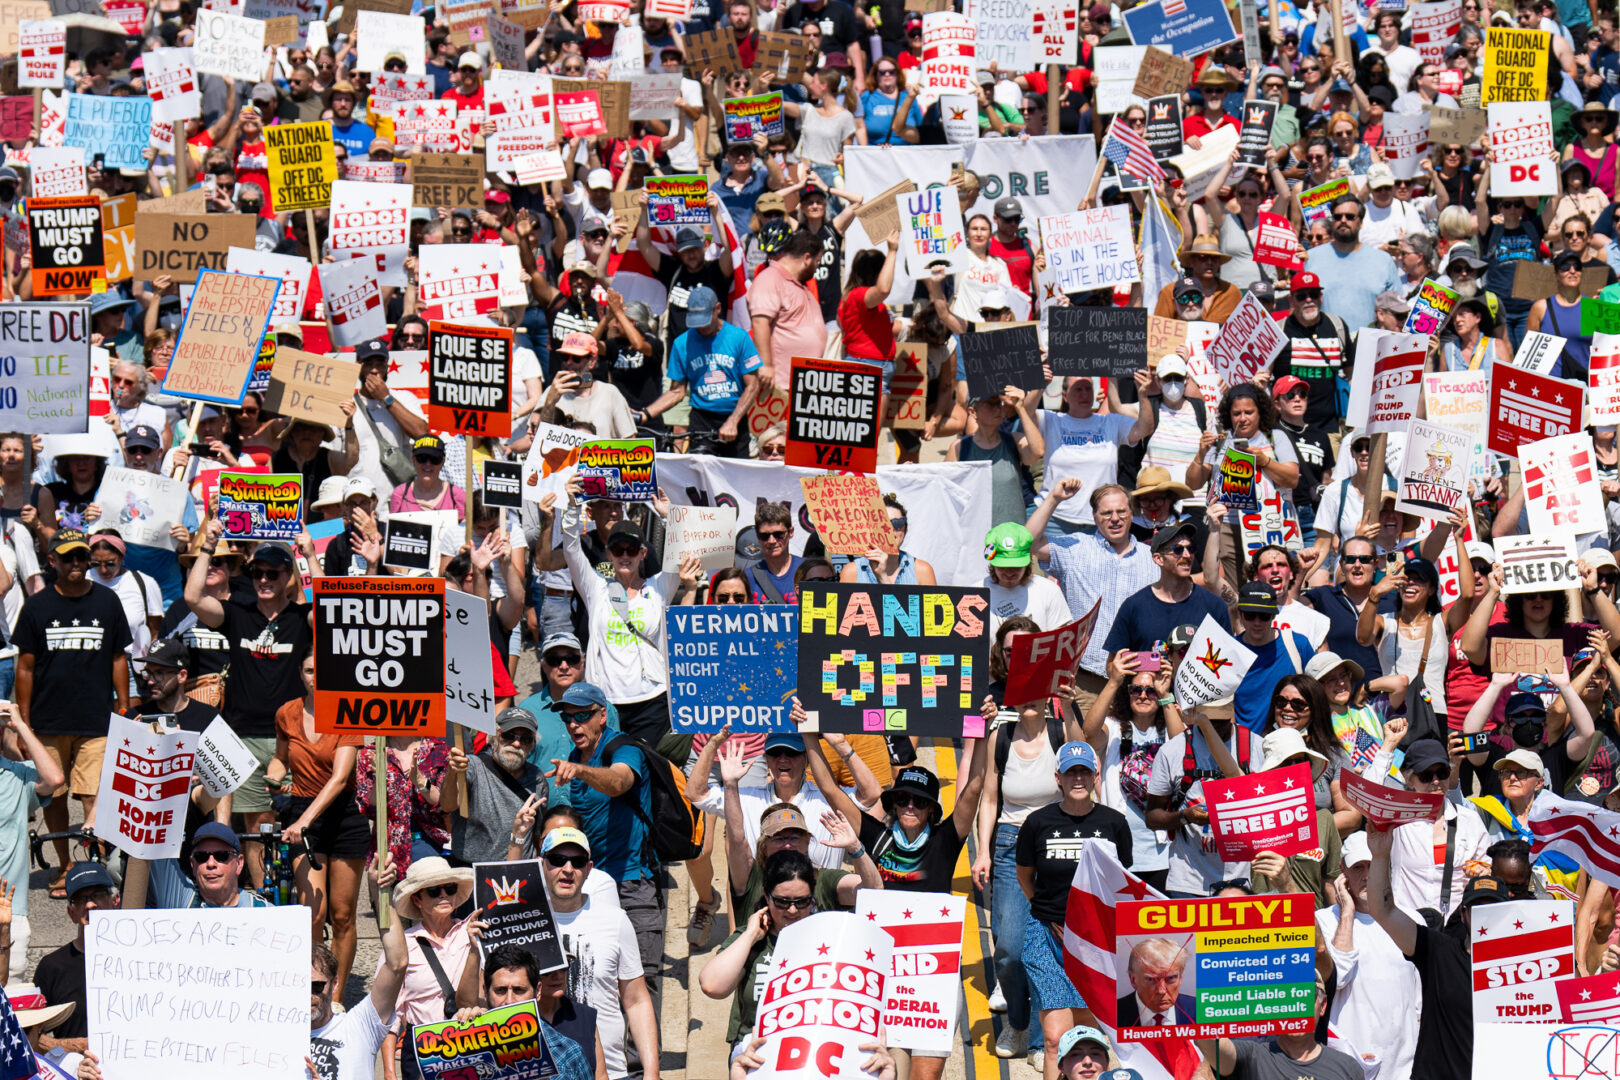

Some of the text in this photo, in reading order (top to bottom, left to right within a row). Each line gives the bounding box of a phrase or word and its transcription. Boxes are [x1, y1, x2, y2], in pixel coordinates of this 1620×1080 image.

[1413, 7, 1460, 29] PROTECT
[923, 27, 975, 44] PROTECT
[1043, 36, 1065, 44] ALL
[1151, 16, 1215, 44] the Occupation
[1489, 31, 1545, 50] NATIONAL
[1046, 47, 1062, 56] DC
[1496, 50, 1536, 68] GUARD
[25, 61, 57, 69] HOME
[28, 70, 55, 78] RULE
[927, 64, 969, 77] HOME
[930, 77, 967, 88] RULE
[1496, 72, 1533, 87] OFF DC
[68, 98, 150, 123] EL PUEBLO
[267, 126, 330, 147] NATIONAL
[1494, 122, 1550, 143] TODOS
[280, 145, 322, 166] GUARD
[283, 167, 323, 186] OFF DC
[1510, 164, 1539, 182] DC
[414, 185, 478, 206] FREE DC
[30, 208, 100, 228] TRUMP
[334, 208, 406, 228] TODOS
[1045, 207, 1120, 230] THE REAL
[39, 227, 94, 247] MUST
[173, 222, 208, 242] NO
[334, 229, 406, 249] SOMOS
[912, 226, 943, 242] THIS
[1044, 230, 1113, 250] CRIMINAL
[914, 231, 963, 255] TOGETHER
[53, 247, 82, 265] GO
[1051, 243, 1119, 266] IS IN THE
[45, 270, 98, 289] NOW!
[1096, 260, 1138, 284] HOUSE
[199, 272, 270, 299] RELEASE
[329, 278, 378, 312] FUERA
[421, 273, 499, 300] FUERA
[199, 297, 269, 317] the EPSTEIN
[441, 299, 477, 316] ICE
[1053, 308, 1146, 331] STOP KIDNAPPING
[434, 337, 505, 360] ¡QUE SE
[292, 360, 331, 387] FREE
[434, 358, 505, 383] LARGUE
[697, 382, 738, 399] AMERICA
[796, 369, 875, 396] ¡QUE SE
[290, 390, 313, 413] DC
[435, 381, 503, 408] TRUMP
[27, 403, 73, 420] Guard
[795, 392, 873, 425] LARGUE
[1374, 402, 1404, 411] TRUMP
[452, 410, 487, 432] YA!
[796, 416, 870, 443] TRUMP
[1499, 407, 1541, 433] FREE
[414, 435, 438, 448] SPIRIT
[814, 444, 853, 467] YA!
[621, 466, 652, 485] NOW
[1410, 470, 1456, 488] PREVENT
[486, 484, 519, 495] FREE DC
[1404, 483, 1462, 508] TYRANNY
[267, 503, 297, 526] NOW
[813, 508, 887, 523] TAKEOVER
[390, 543, 427, 555] FREE DC
[828, 529, 891, 548] CONTROL
[1503, 560, 1578, 585] FREE DC
[321, 581, 435, 592] RefuseFascism.org
[319, 598, 440, 626] TRUMP
[801, 590, 988, 638] HANDS
[675, 612, 794, 634] VERMONT
[332, 628, 428, 657] MUST
[674, 641, 759, 657] RODE ALL
[1495, 641, 1560, 667] FREE DC
[355, 659, 405, 687] GO
[675, 663, 720, 676] NIGHT
[822, 649, 973, 709] OFF!
[1185, 660, 1224, 697] NO KINGS.
[677, 682, 697, 696] TO
[335, 698, 431, 726] NOW!
[678, 705, 785, 726] SUPPORT
[119, 754, 192, 776] PROTECT
[204, 736, 241, 783] TAKEOVER.
[135, 781, 162, 800] DC
[118, 798, 174, 827] HOME
[1219, 806, 1309, 835] FREE DC
[119, 818, 167, 844] RULE
[482, 910, 544, 925] NO KINGS.
[1138, 899, 1292, 929] GUILTY!
[95, 917, 302, 955] ROSES ARE RED
[484, 919, 549, 938] NO TRUMP
[1203, 932, 1309, 948] Impeached Twice
[1201, 953, 1310, 969] Convicted of 34
[92, 953, 307, 993] FRASIER'S BROTHER IS NILES
[771, 963, 880, 1001] TODOS
[1228, 970, 1283, 982] Felonies
[1486, 957, 1560, 988] STOP
[896, 985, 916, 995] the
[1201, 988, 1311, 1004] Found Liable for
[1515, 992, 1534, 1000] the
[90, 986, 311, 1027] TRUMP SHOULD RELEASE
[1204, 1002, 1307, 1018] Sexual Assault
[1496, 1003, 1553, 1017] TRUMP
[762, 1000, 877, 1036] SOMOS
[1122, 1019, 1309, 1040] Haven't We Had Enough Yet?
[92, 1031, 289, 1072] THE EPSTEIN FILES
[495, 1040, 539, 1069] NOW
[775, 1036, 844, 1080] DC
